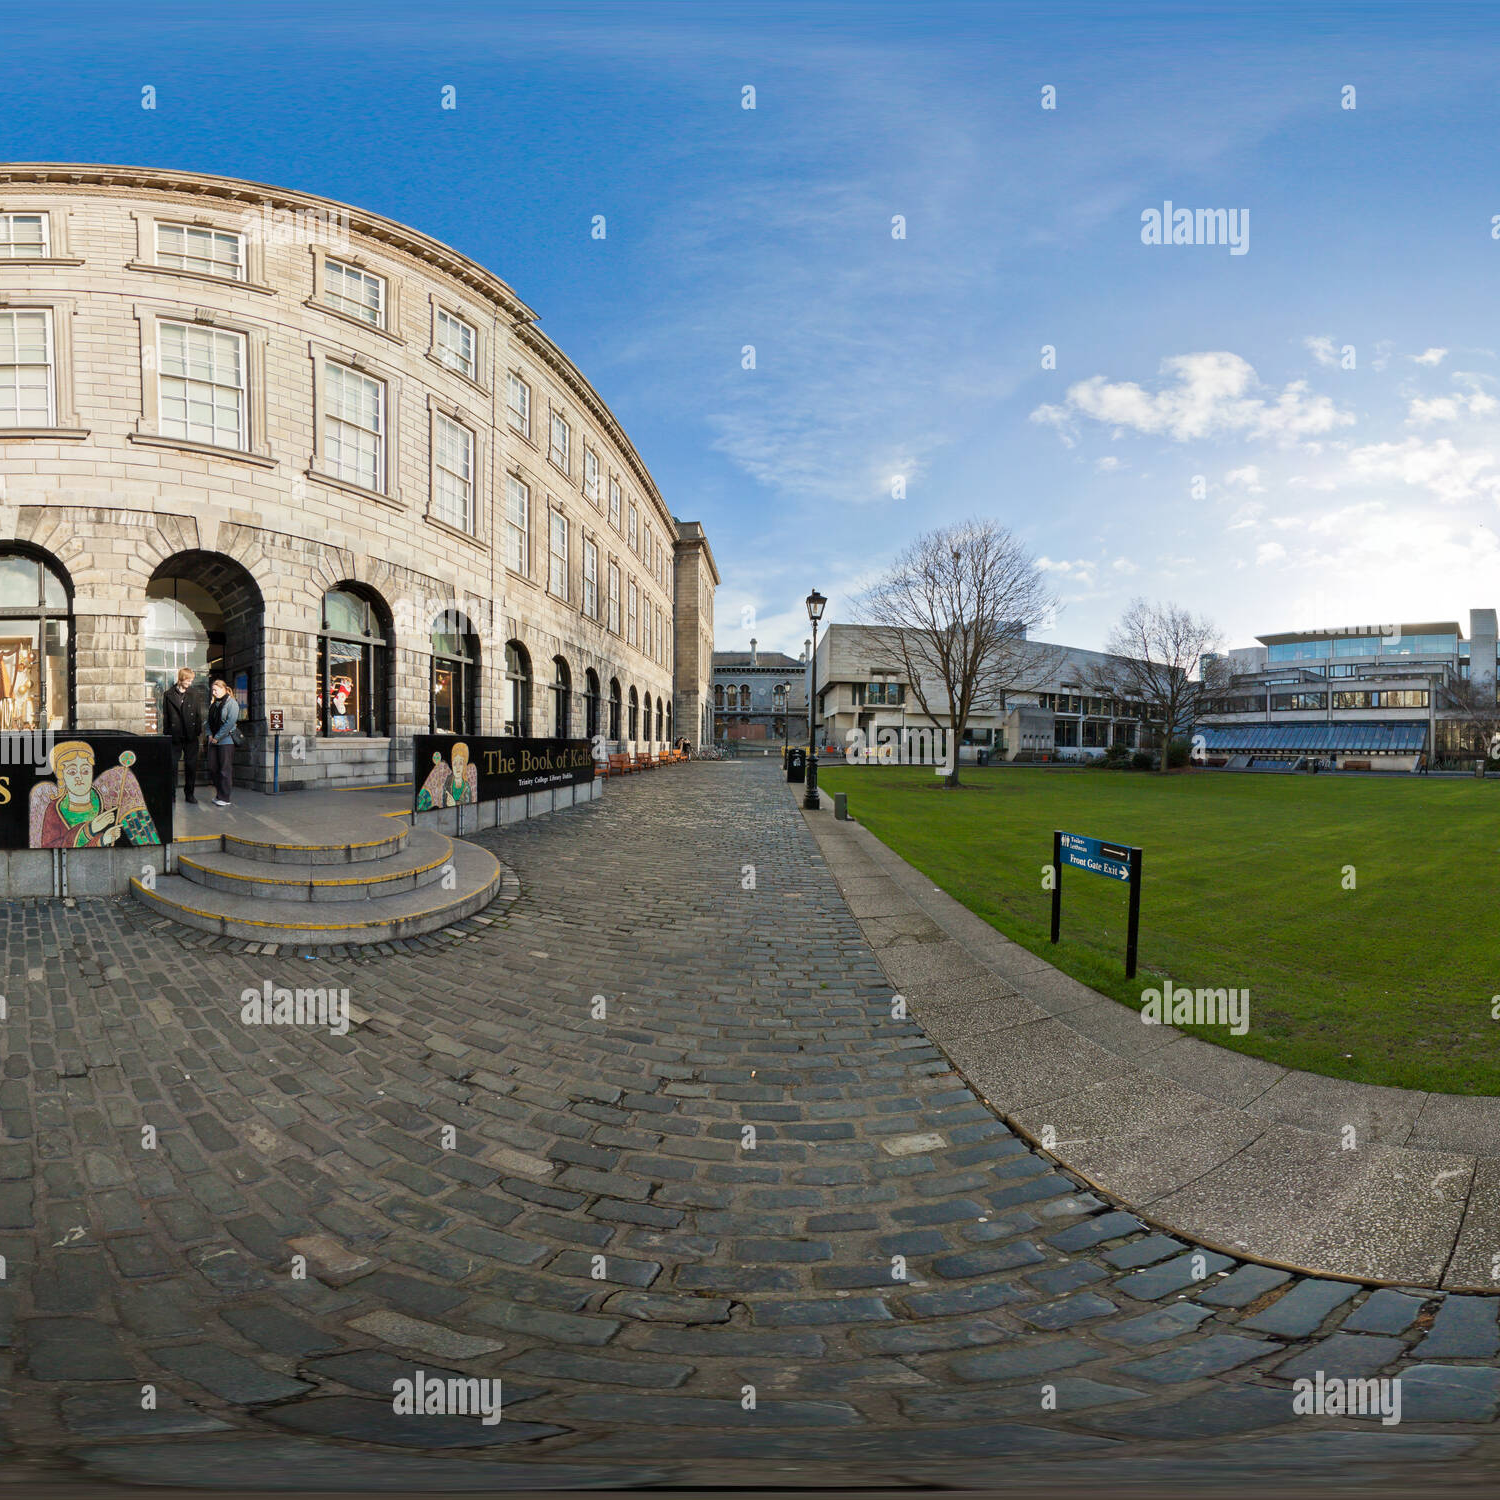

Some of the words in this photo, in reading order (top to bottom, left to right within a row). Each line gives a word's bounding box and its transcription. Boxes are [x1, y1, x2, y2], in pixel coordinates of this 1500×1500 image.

[484, 749, 516, 775] The
[521, 748, 554, 772] Book
[556, 748, 569, 769] of
[570, 747, 592, 767] Kells
[1070, 853, 1086, 867] Front
[1087, 858, 1102, 871] Gate
[1103, 862, 1118, 876] Exit
